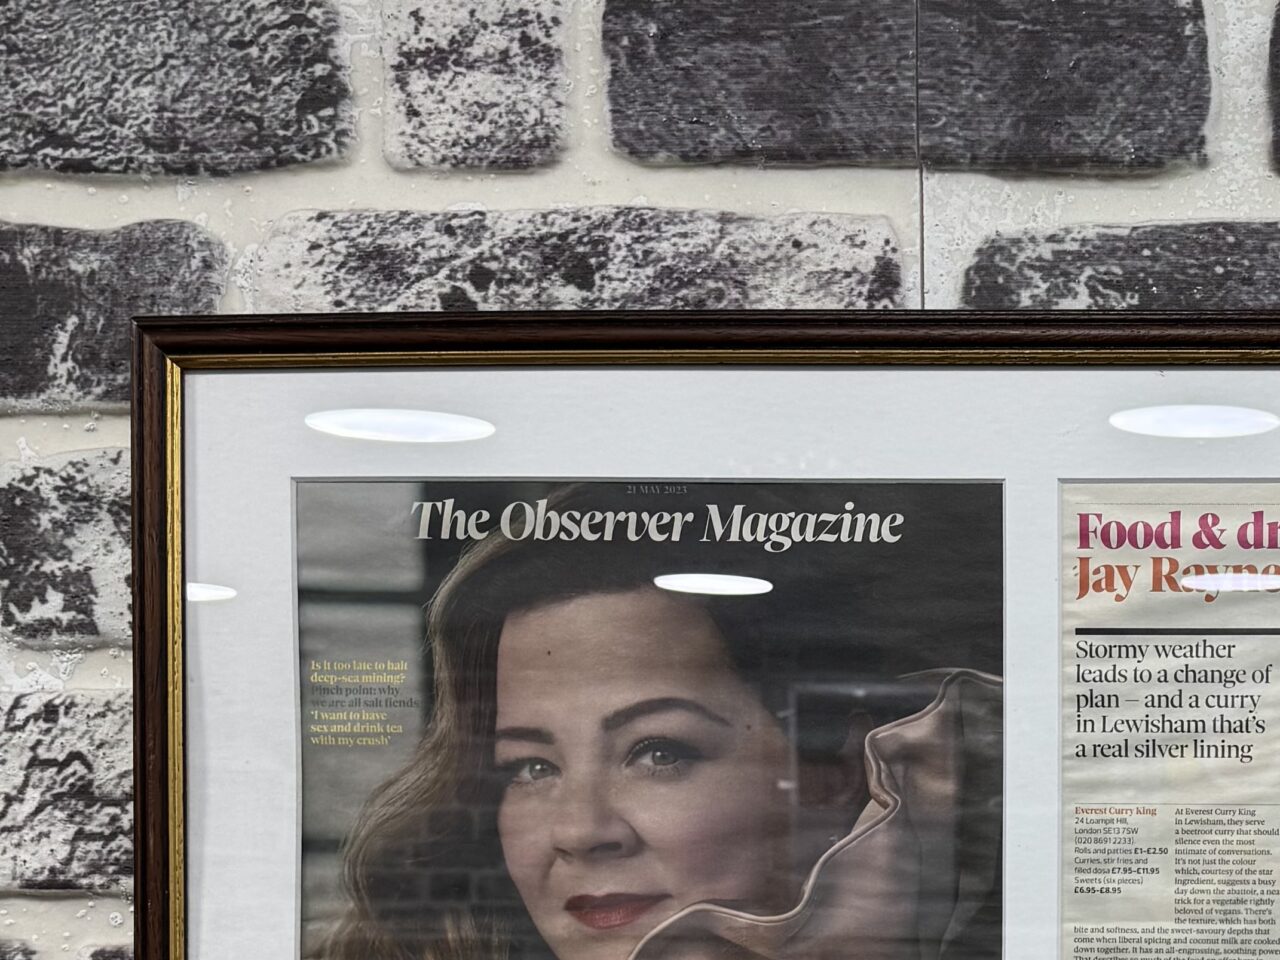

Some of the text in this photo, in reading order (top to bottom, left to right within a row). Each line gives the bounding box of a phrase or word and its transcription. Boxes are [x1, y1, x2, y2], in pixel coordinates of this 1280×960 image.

[626, 486, 688, 494] 21 MAY 2023
[410, 498, 905, 553] The Observer Magazine
[1076, 510, 1182, 550] Food
[1192, 512, 1227, 550] &
[1075, 556, 1141, 603] Jay
[1075, 639, 1236, 663] Stormy weather
[311, 660, 408, 671] Is it too late to halt
[310, 672, 406, 685] deep-sea mining?
[1076, 663, 1273, 688] leads to a change of
[1075, 688, 1120, 713] plan
[1144, 688, 1183, 709] and
[1188, 694, 1200, 709] a
[1205, 694, 1261, 714] curry
[320, 711, 348, 721] want
[349, 711, 360, 721] to
[362, 710, 387, 721] have
[310, 722, 403, 734] sex and drink tea
[1076, 714, 1266, 734] in Lewisham that’s
[310, 734, 335, 745] with
[338, 737, 354, 748] my
[1075, 738, 1254, 764] a real silver lining
[1075, 806, 1157, 817] Everest Curry King
[1074, 817, 1129, 826] 24 Loampit Hill,
[1075, 827, 1139, 835] London SE13 7SW
[1075, 847, 1091, 855] Rolls
[1093, 847, 1107, 855] and
[1107, 847, 1133, 856] patties
